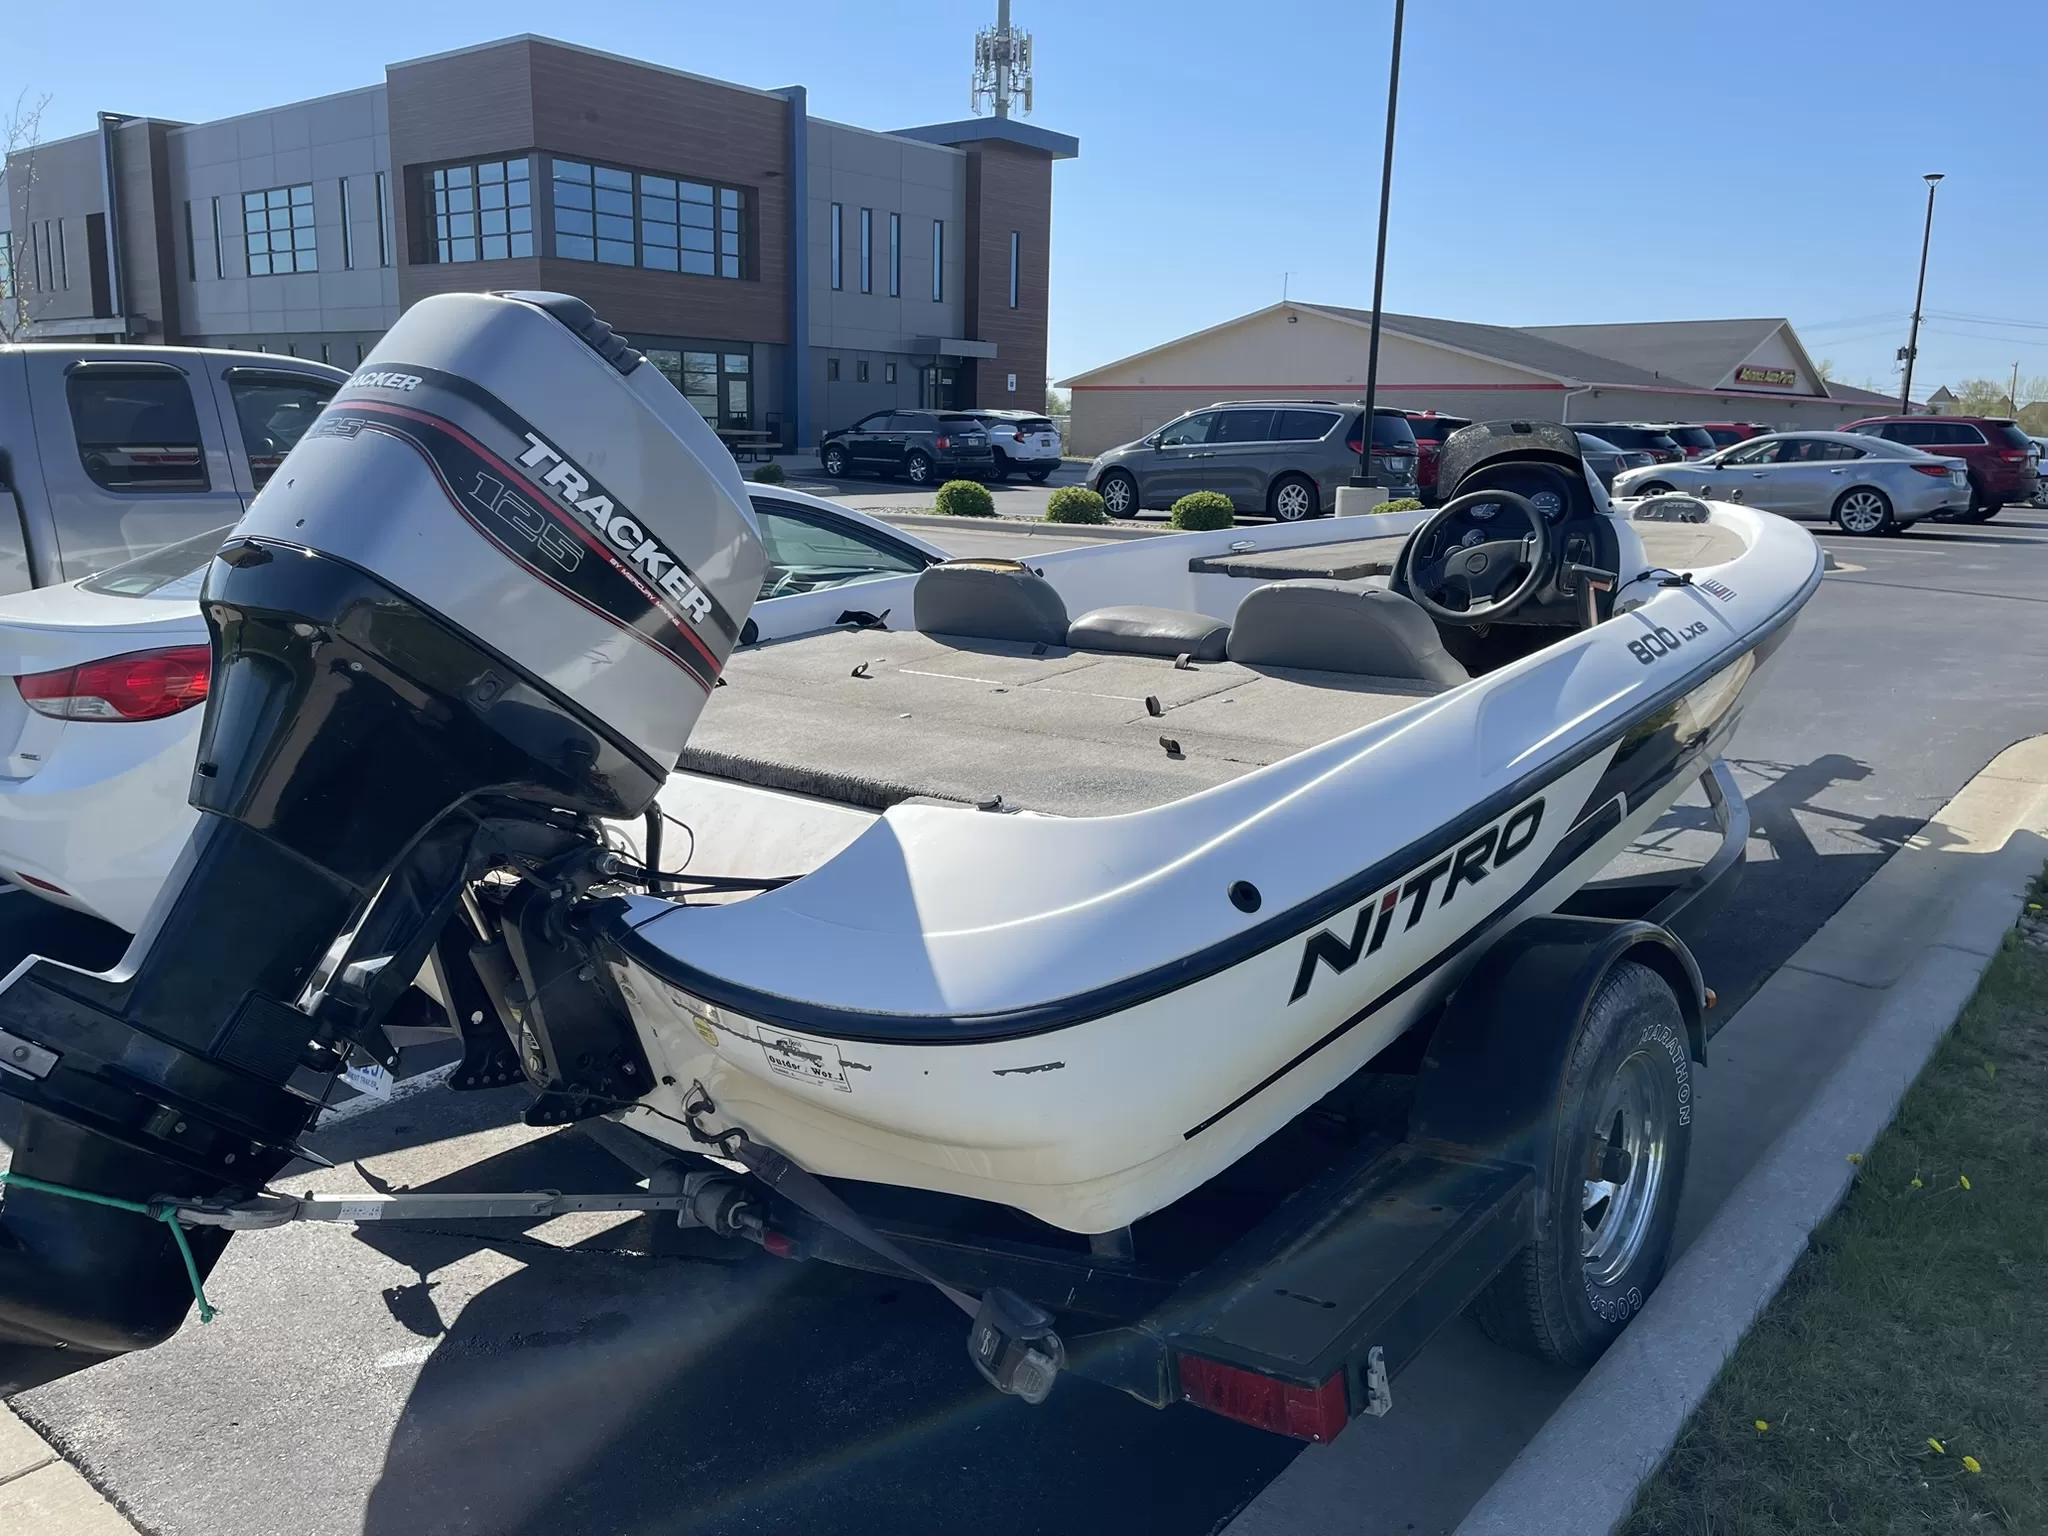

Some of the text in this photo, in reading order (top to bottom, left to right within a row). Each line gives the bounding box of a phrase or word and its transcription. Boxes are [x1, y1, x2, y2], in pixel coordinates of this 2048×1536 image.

[468, 471, 585, 572] 125
[518, 432, 713, 624] TRACKER
[610, 557, 622, 569] BY
[621, 568, 656, 600] MERCURY
[1627, 627, 1681, 665] 800
[1287, 796, 1546, 1007] NITRO
[1638, 1024, 1691, 1126] MARATHON
